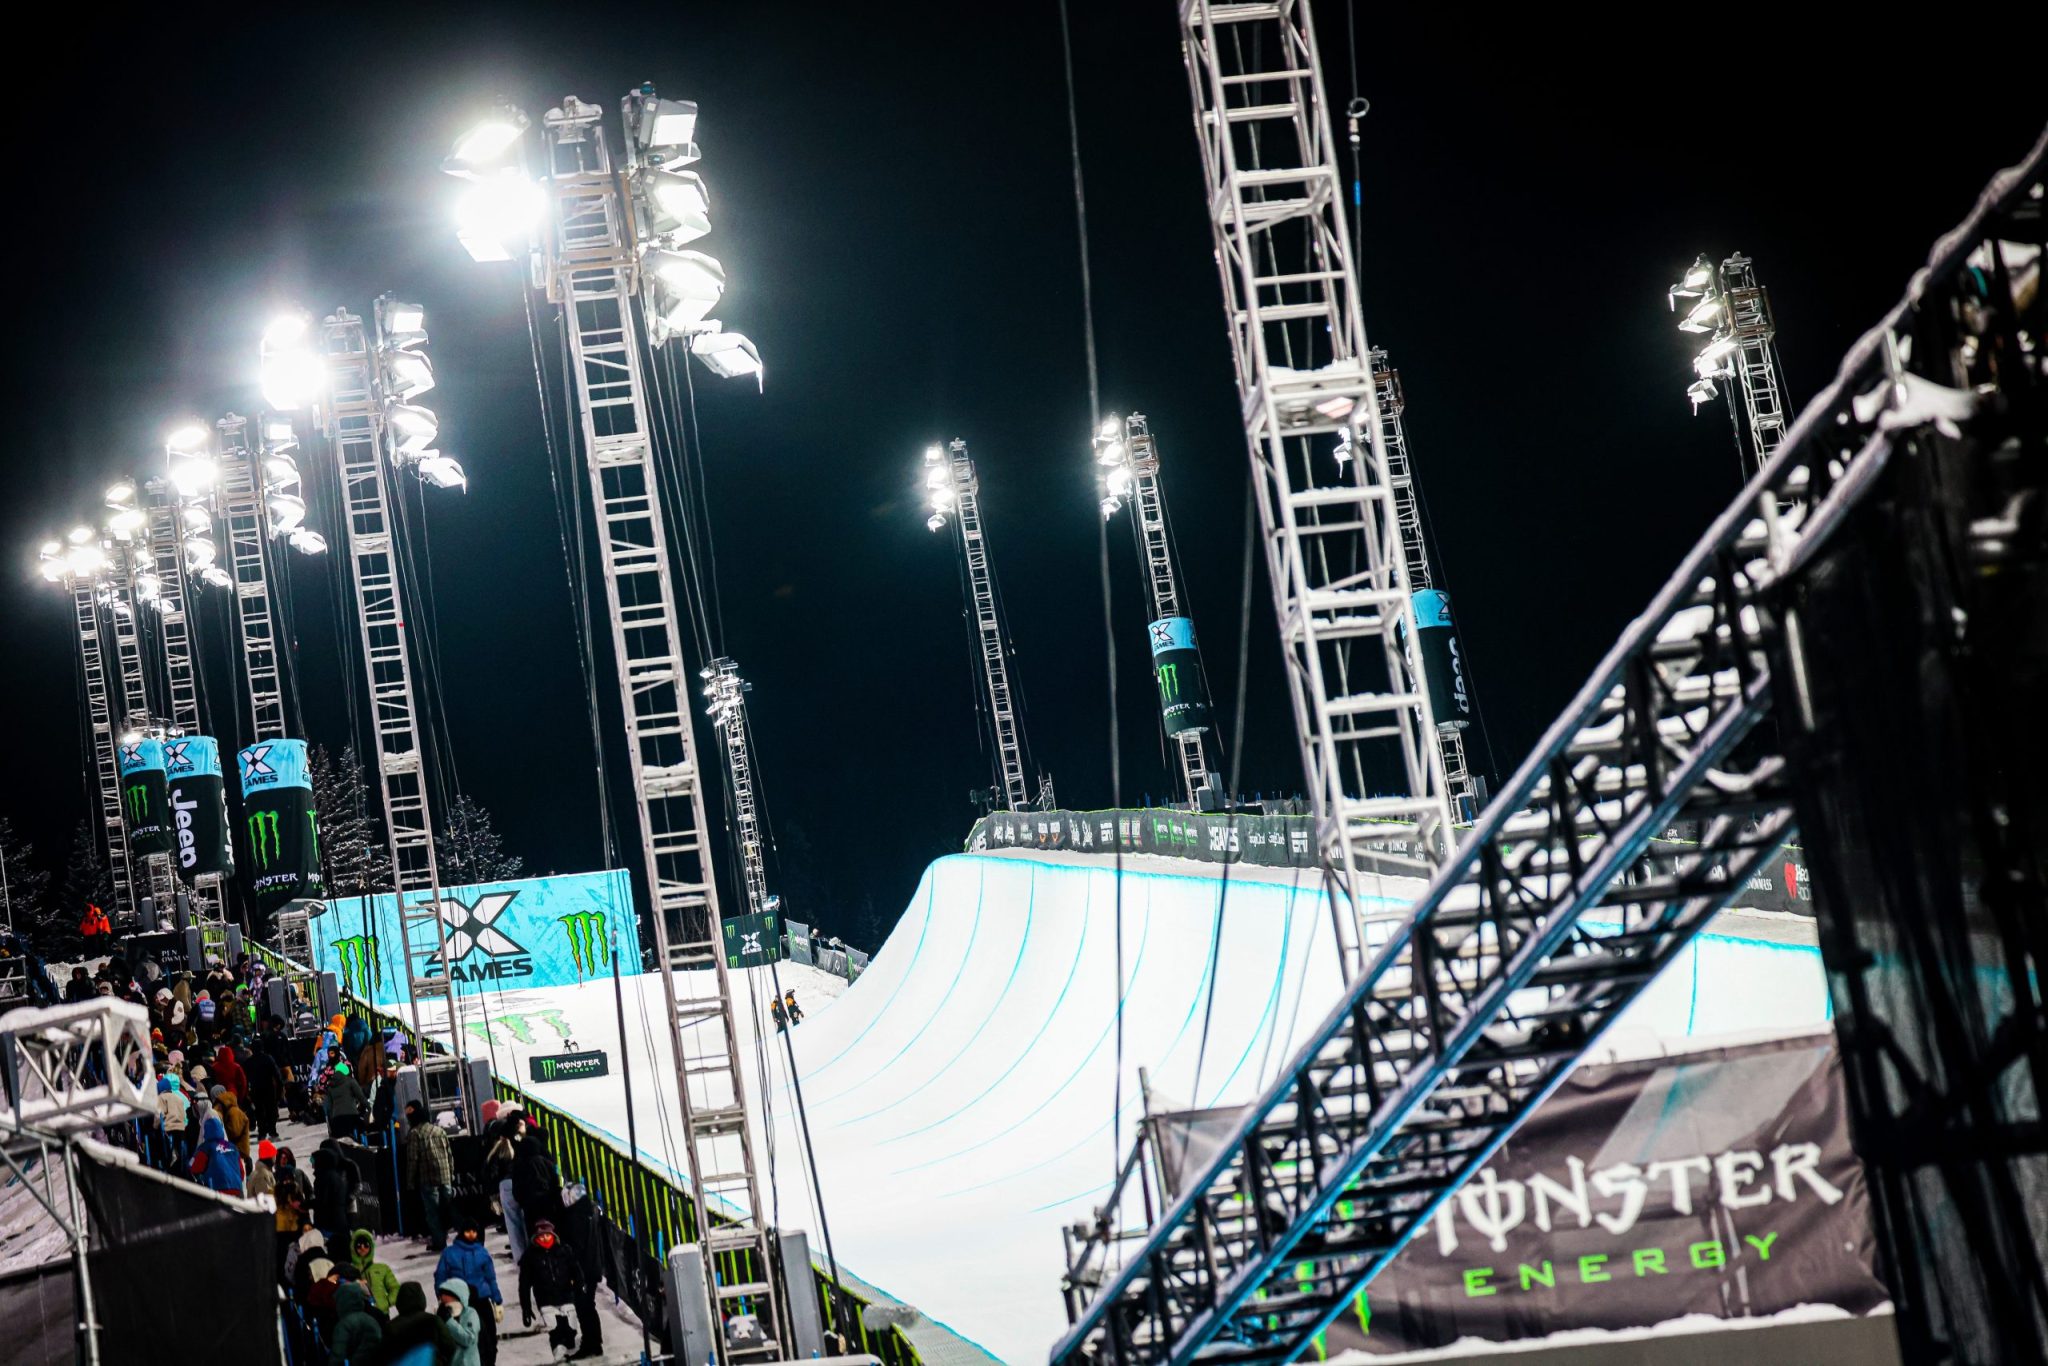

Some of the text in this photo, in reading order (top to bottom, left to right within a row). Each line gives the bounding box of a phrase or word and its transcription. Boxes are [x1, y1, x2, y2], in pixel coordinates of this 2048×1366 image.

[171, 788, 198, 868] Jeep
[556, 1058, 601, 1071] MONSTER
[1462, 1231, 1779, 1298] ENERGY
